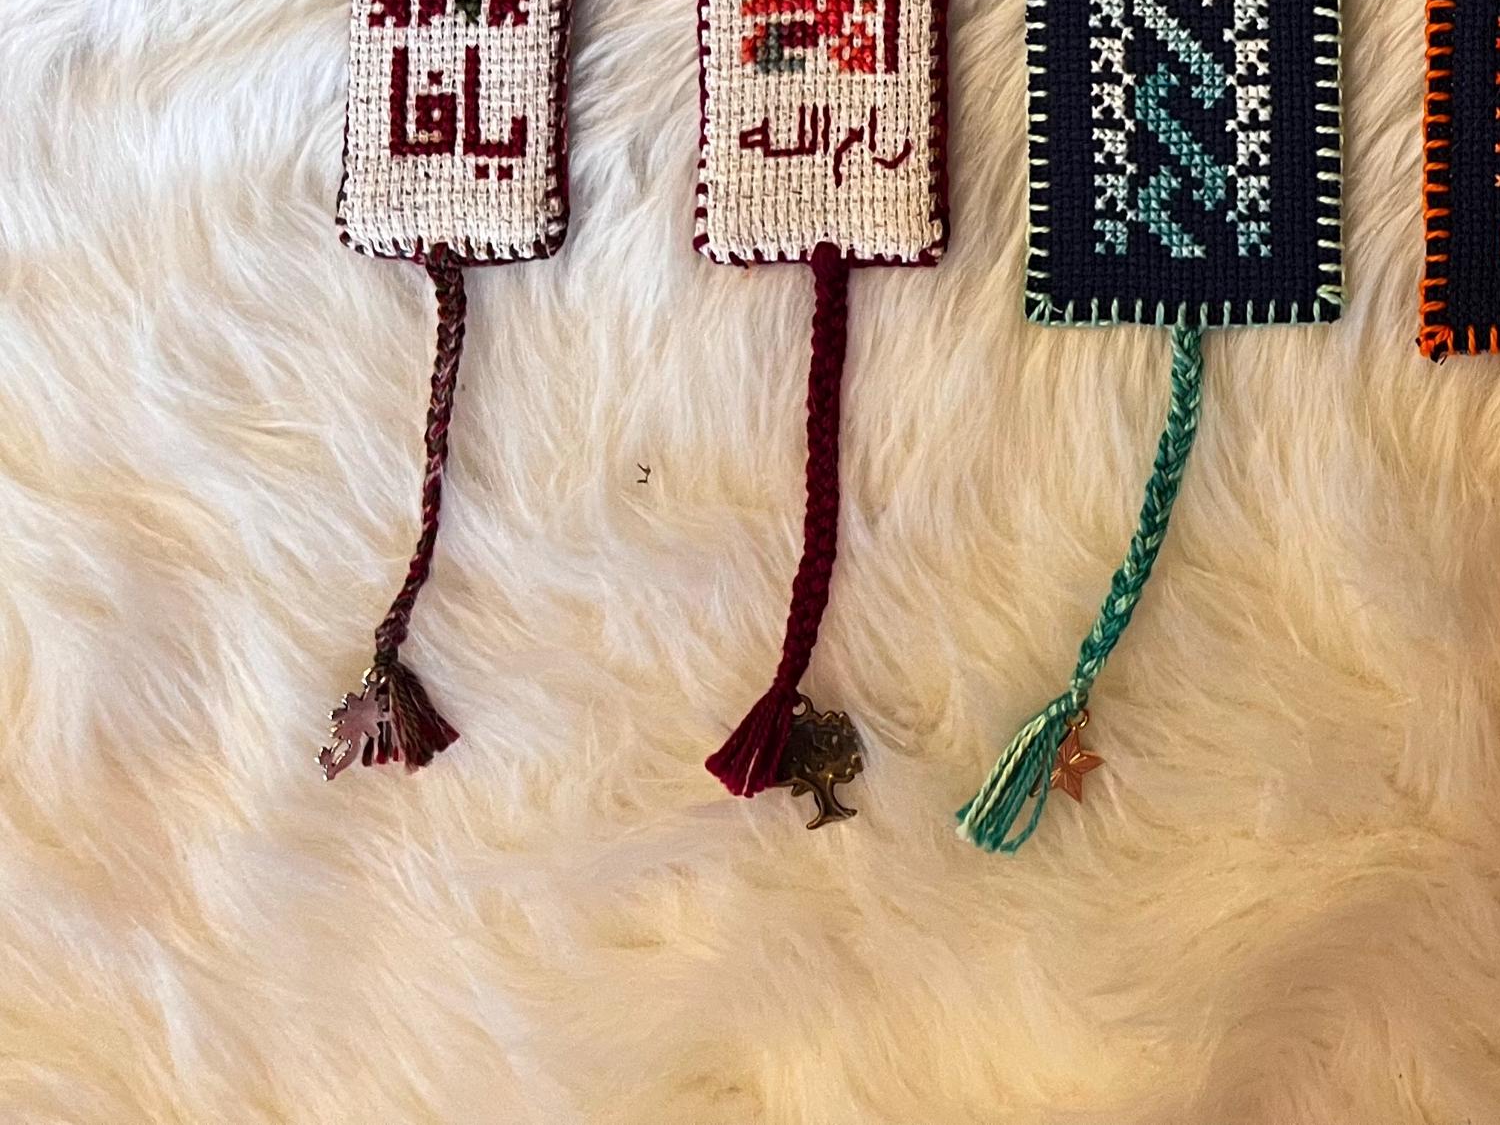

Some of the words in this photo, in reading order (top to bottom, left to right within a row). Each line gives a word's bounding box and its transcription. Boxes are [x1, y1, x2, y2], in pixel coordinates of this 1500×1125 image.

[389, 43, 528, 181] يافا
[739, 102, 831, 158] الله
[833, 103, 913, 189] رام
